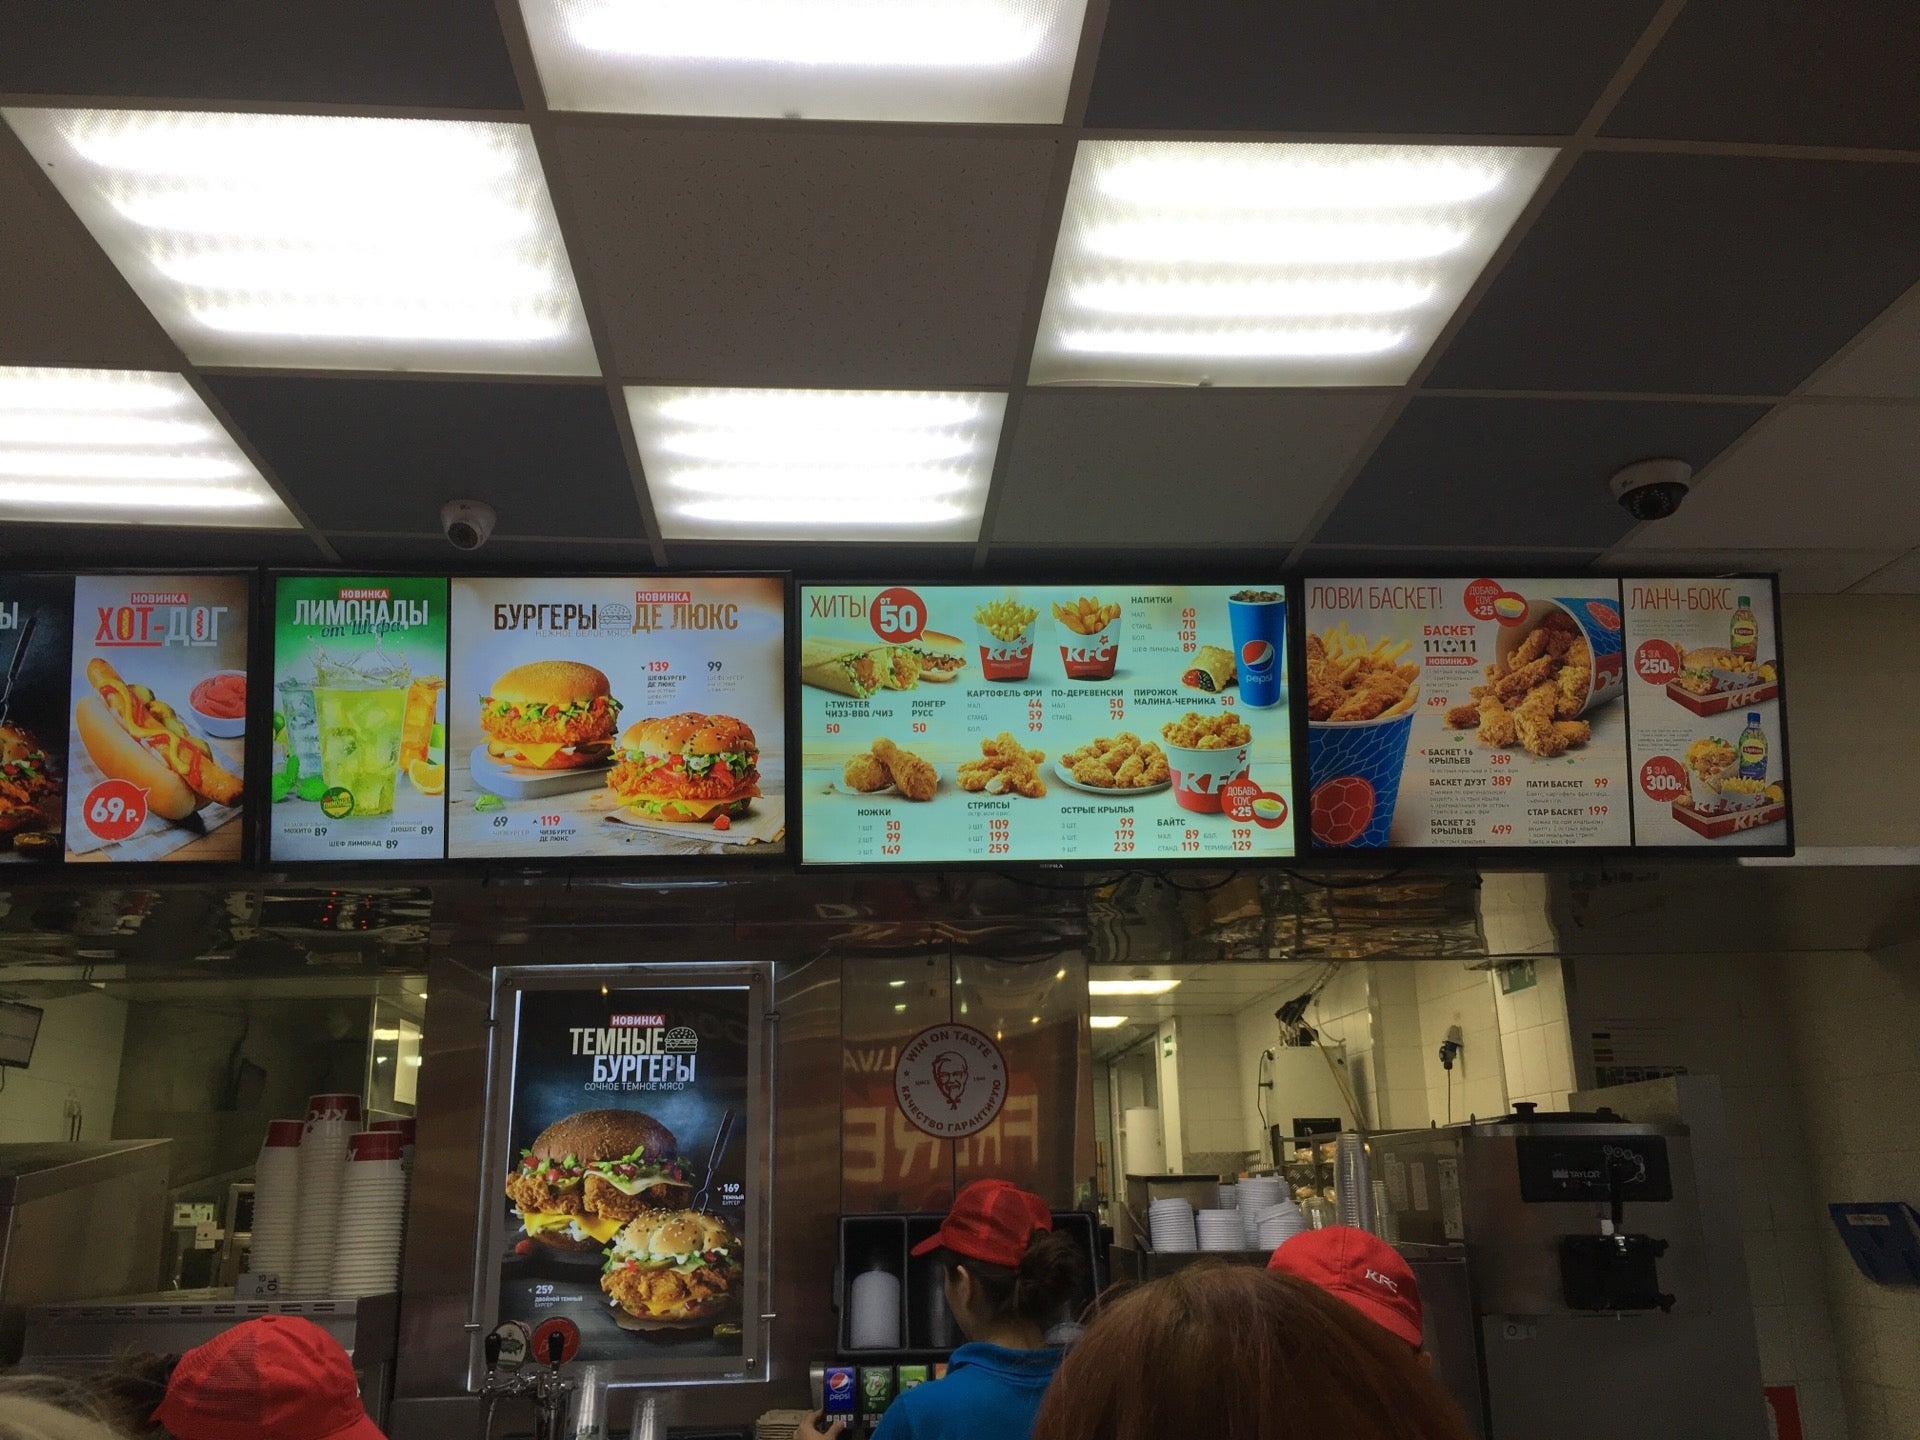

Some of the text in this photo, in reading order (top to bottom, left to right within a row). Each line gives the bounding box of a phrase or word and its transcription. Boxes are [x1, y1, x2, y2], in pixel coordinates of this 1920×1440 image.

[341, 589, 388, 599] НОВИНКА
[1469, 586, 1499, 596] ДОБАВЬ
[132, 594, 187, 604] НОВИНКА
[637, 592, 690, 602] НОВИНКА
[1131, 596, 1172, 604] НАПИТКИ
[1311, 586, 1443, 609] ЛОВИ БАСКЕТ!
[1631, 587, 1734, 610] ЛАНЧ-БОКС
[810, 595, 866, 618] ХИТЫ
[1473, 605, 1493, 615] +25
[293, 600, 429, 630] ЛИМОНАДЫ
[1182, 608, 1196, 618] 60
[494, 603, 738, 634] БУРГЕРЫ ДЕ ЛЮКС
[880, 604, 918, 633] 50
[95, 606, 228, 647] ХОТ-ДОГ
[1183, 620, 1196, 629] 70
[321, 625, 345, 638] от
[1424, 625, 1476, 636] БАСКЕТ
[1177, 631, 1196, 641] 105
[1183, 643, 1197, 652] 89
[1424, 640, 1476, 652] 11 11
[987, 646, 1028, 661] KFC
[1066, 646, 1110, 662] KFC
[648, 661, 669, 671] 139
[707, 661, 722, 671] 99
[1429, 657, 1468, 665] НОВИНКА
[1246, 673, 1273, 684] pepsi
[967, 689, 1042, 697] КАРТОФЕЛЬ ФРИ
[1051, 689, 1124, 697] ПО-ДЕРЕВЕНСКИ
[912, 700, 946, 708] ЛОНГЕР
[1028, 699, 1042, 708] 44
[1110, 699, 1123, 708] 50
[1221, 696, 1234, 705] 50
[1428, 697, 1447, 706] 499
[912, 709, 933, 717] РУСС
[1029, 711, 1042, 720] 59
[1110, 710, 1124, 720] 79
[826, 724, 840, 733] 50
[912, 723, 926, 732] 50
[1028, 722, 1042, 732] 99
[1428, 748, 1461, 756] БАСКЕТ
[1429, 757, 1471, 765] КРЫЛЬЕВ
[1490, 755, 1511, 764] 389
[1491, 776, 1512, 786] 389
[1527, 778, 1608, 788] ПАТИ БАСКЕТ 99
[1227, 786, 1257, 796] ДОБАВЬ
[967, 801, 1010, 809] СТРИПСЫ
[1233, 796, 1251, 806] СОУС
[858, 808, 891, 816] НОЖКИ
[1061, 806, 1096, 814] ОСТРЫЕ
[1231, 806, 1252, 817] +25
[1527, 806, 1608, 816] СТАР БАСКЕТ 199
[493, 816, 508, 827] 69
[541, 815, 561, 827] 119
[886, 821, 900, 831] 50
[989, 820, 1009, 829] 109
[1120, 818, 1134, 828] 99
[1157, 817, 1186, 827] БАЙТС
[314, 827, 328, 836] 89
[421, 826, 434, 835] 89
[1185, 829, 1251, 839] 89 199
[1492, 824, 1512, 834] 499
[886, 833, 900, 843] 99
[989, 832, 1009, 841] 199
[1114, 830, 1134, 839] 179
[347, 840, 382, 848] ЛИМОНАД
[386, 840, 399, 849] 89
[989, 844, 1009, 853] 259
[1114, 842, 1135, 852] 239
[1182, 841, 1199, 851] 119
[1231, 841, 1251, 851] 129
[881, 845, 900, 855] 149
[612, 1016, 663, 1026] НОВИНКА
[570, 1027, 665, 1055] ТЕМНЫЕ
[906, 1040, 929, 1062] WIN
[930, 1031, 949, 1043] ON
[953, 1031, 992, 1059] TASTE
[593, 1055, 696, 1083] БУРГЕРЫ
[584, 1082, 684, 1091] СОЧНОЕ ТЕМНОЕ МЯСО
[901, 1079, 1001, 1132] КАЧЕСТВО ГАРАНТИРУЮ
[723, 1183, 740, 1193] 169
[1365, 1268, 1398, 1293] KFC
[536, 1284, 553, 1294] 259
[829, 1392, 851, 1402] pepsi
